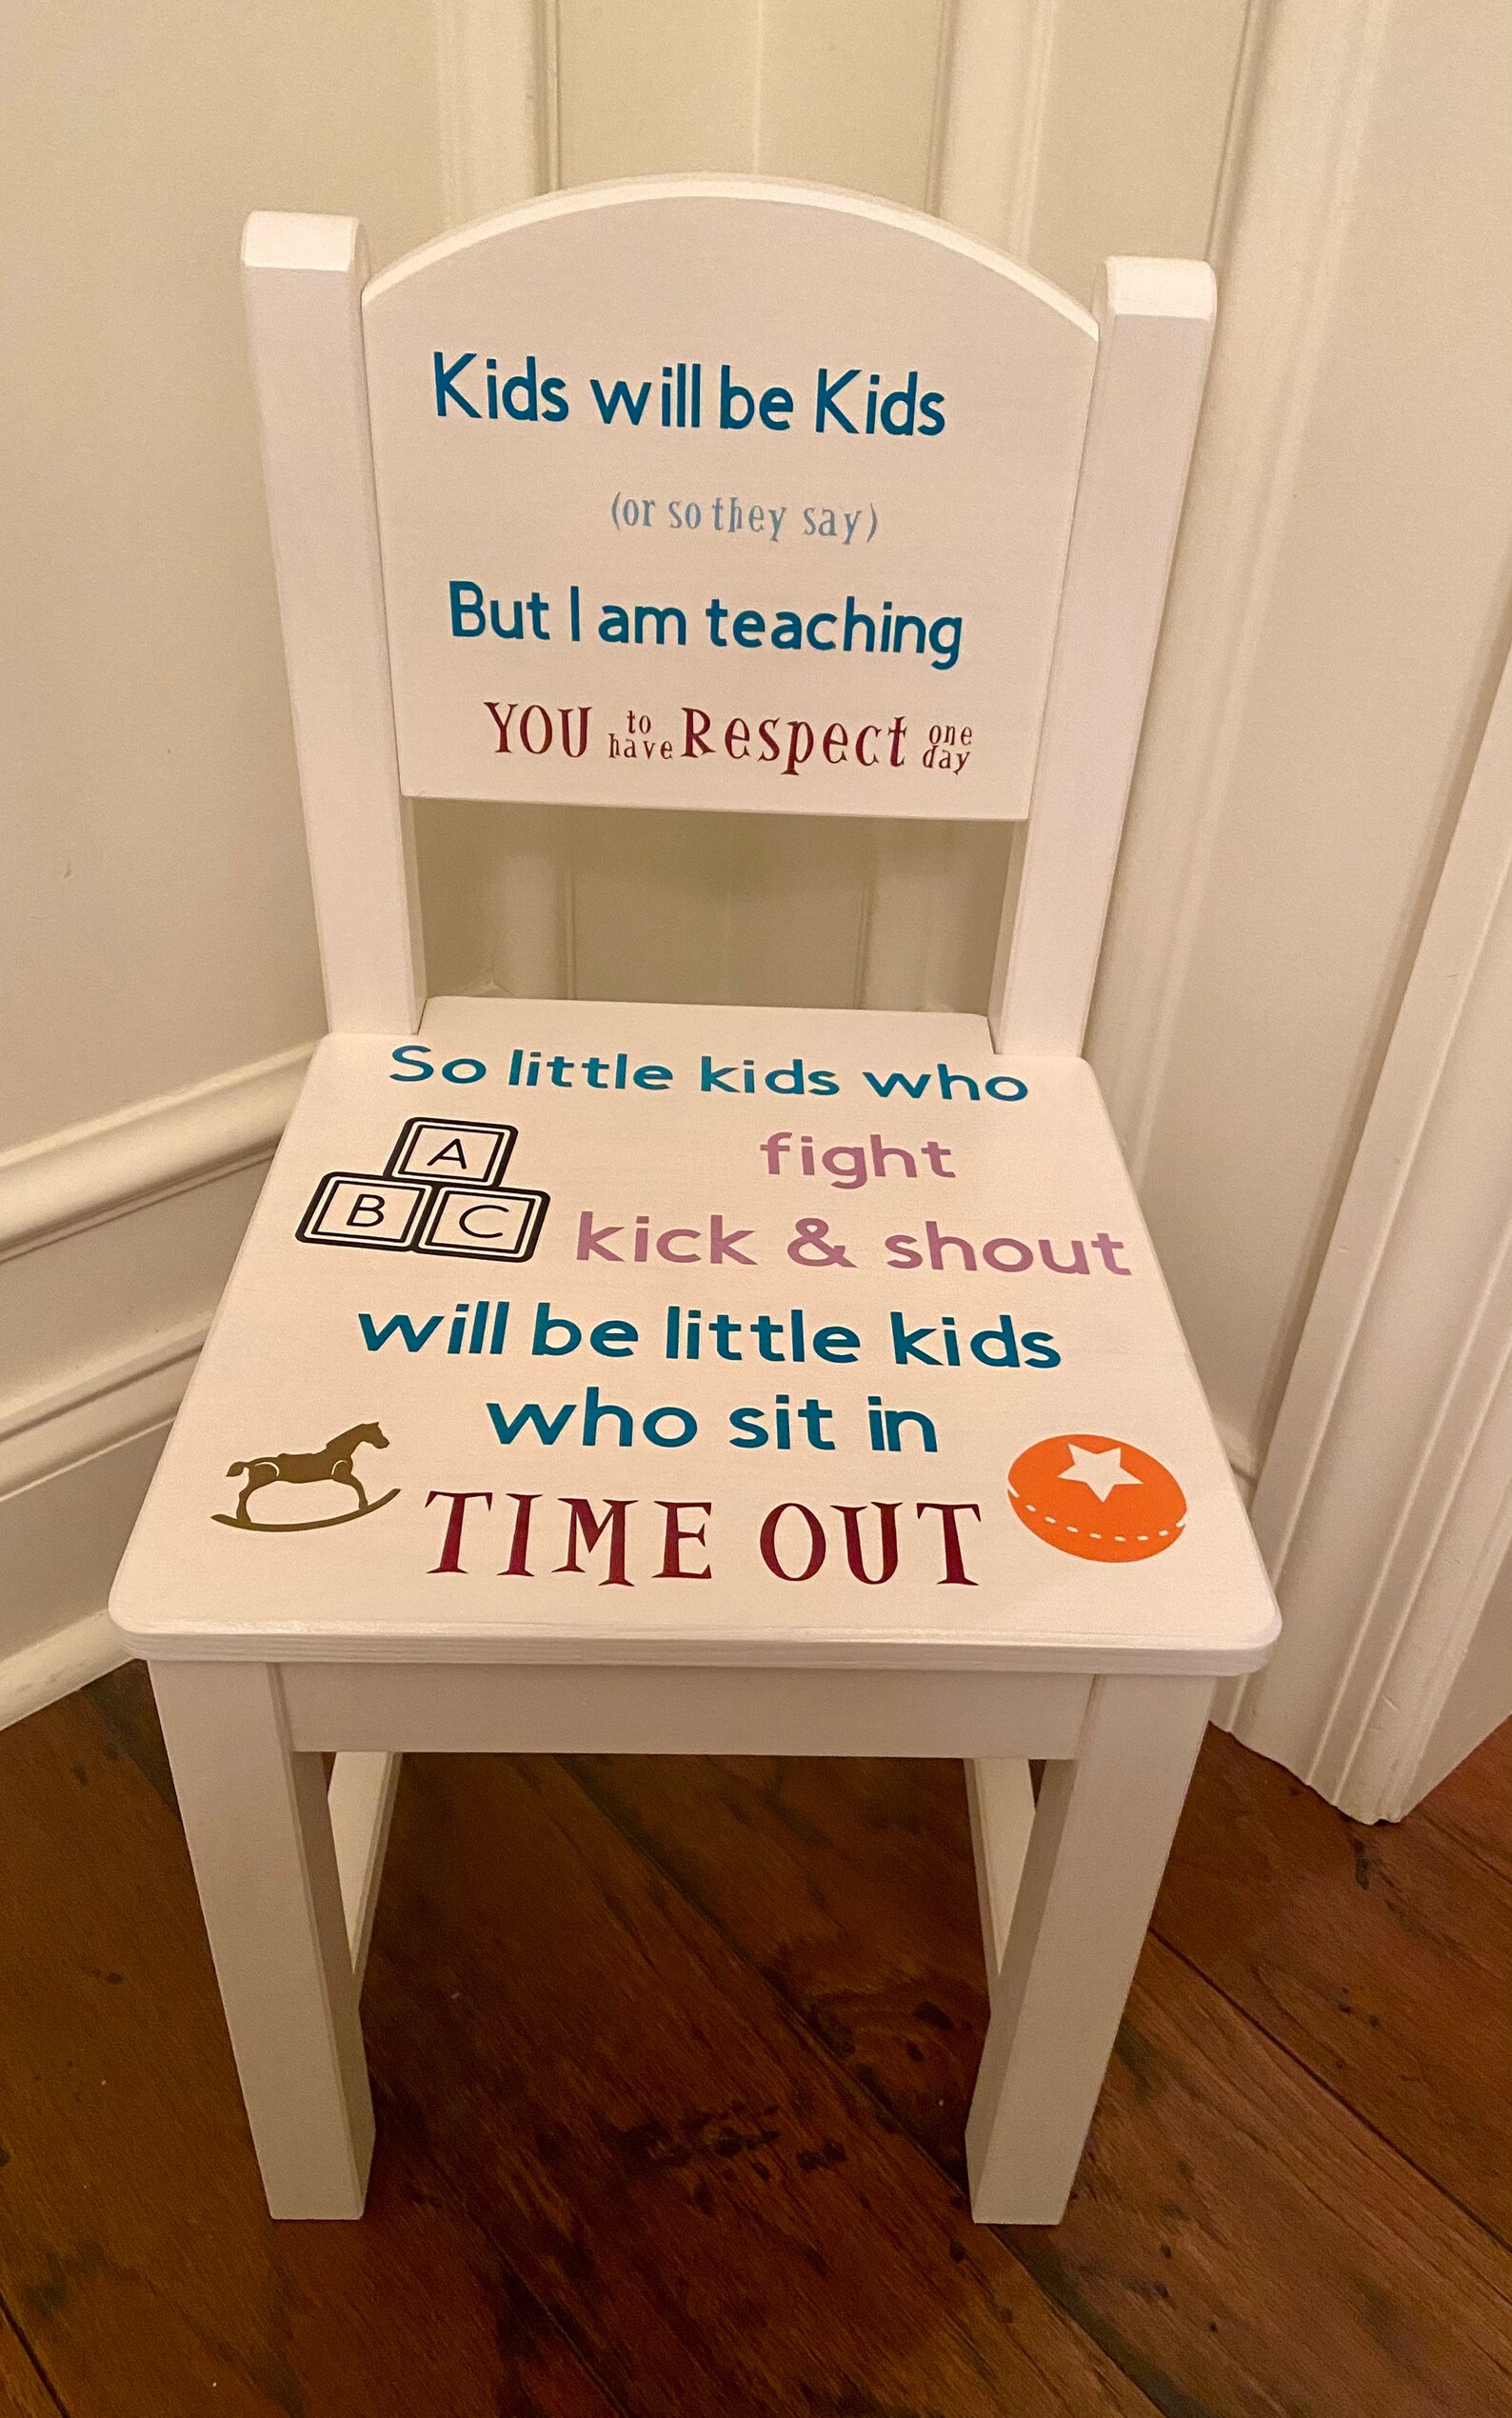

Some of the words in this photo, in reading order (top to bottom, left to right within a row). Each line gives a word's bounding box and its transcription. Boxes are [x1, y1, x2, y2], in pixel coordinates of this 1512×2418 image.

[433, 350, 569, 423] Kids
[589, 362, 701, 428] will
[719, 365, 794, 431] be
[815, 368, 945, 436] Kids
[611, 492, 656, 530] (or
[668, 501, 702, 530] so
[712, 497, 786, 542] they
[804, 504, 878, 545] say)
[449, 580, 550, 640] But
[569, 585, 580, 642] I
[598, 604, 687, 646] am
[706, 596, 963, 670] teaching
[484, 702, 592, 758] YOU
[608, 732, 673, 760] have
[626, 710, 652, 735] to
[681, 708, 907, 775] Respect
[927, 724, 972, 747] one
[923, 746, 970, 775] day
[389, 1045, 487, 1085] So
[507, 1048, 673, 1091] little
[700, 1056, 840, 1096] kids
[862, 1064, 1028, 1102] who
[427, 1137, 467, 1170] A
[760, 1132, 956, 1189] fight
[346, 1193, 385, 1229] B
[458, 1204, 509, 1239] C
[577, 1211, 758, 1265] kick
[787, 1218, 857, 1268] &
[885, 1221, 1131, 1275] shout
[358, 1299, 509, 1356] will
[531, 1301, 640, 1358] be
[665, 1305, 861, 1365] little
[889, 1310, 1062, 1369] kids
[486, 1386, 697, 1449] who
[728, 1393, 836, 1451] sit
[867, 1394, 938, 1453] in
[425, 1489, 712, 1587] TIME
[760, 1502, 981, 1586] OUT
